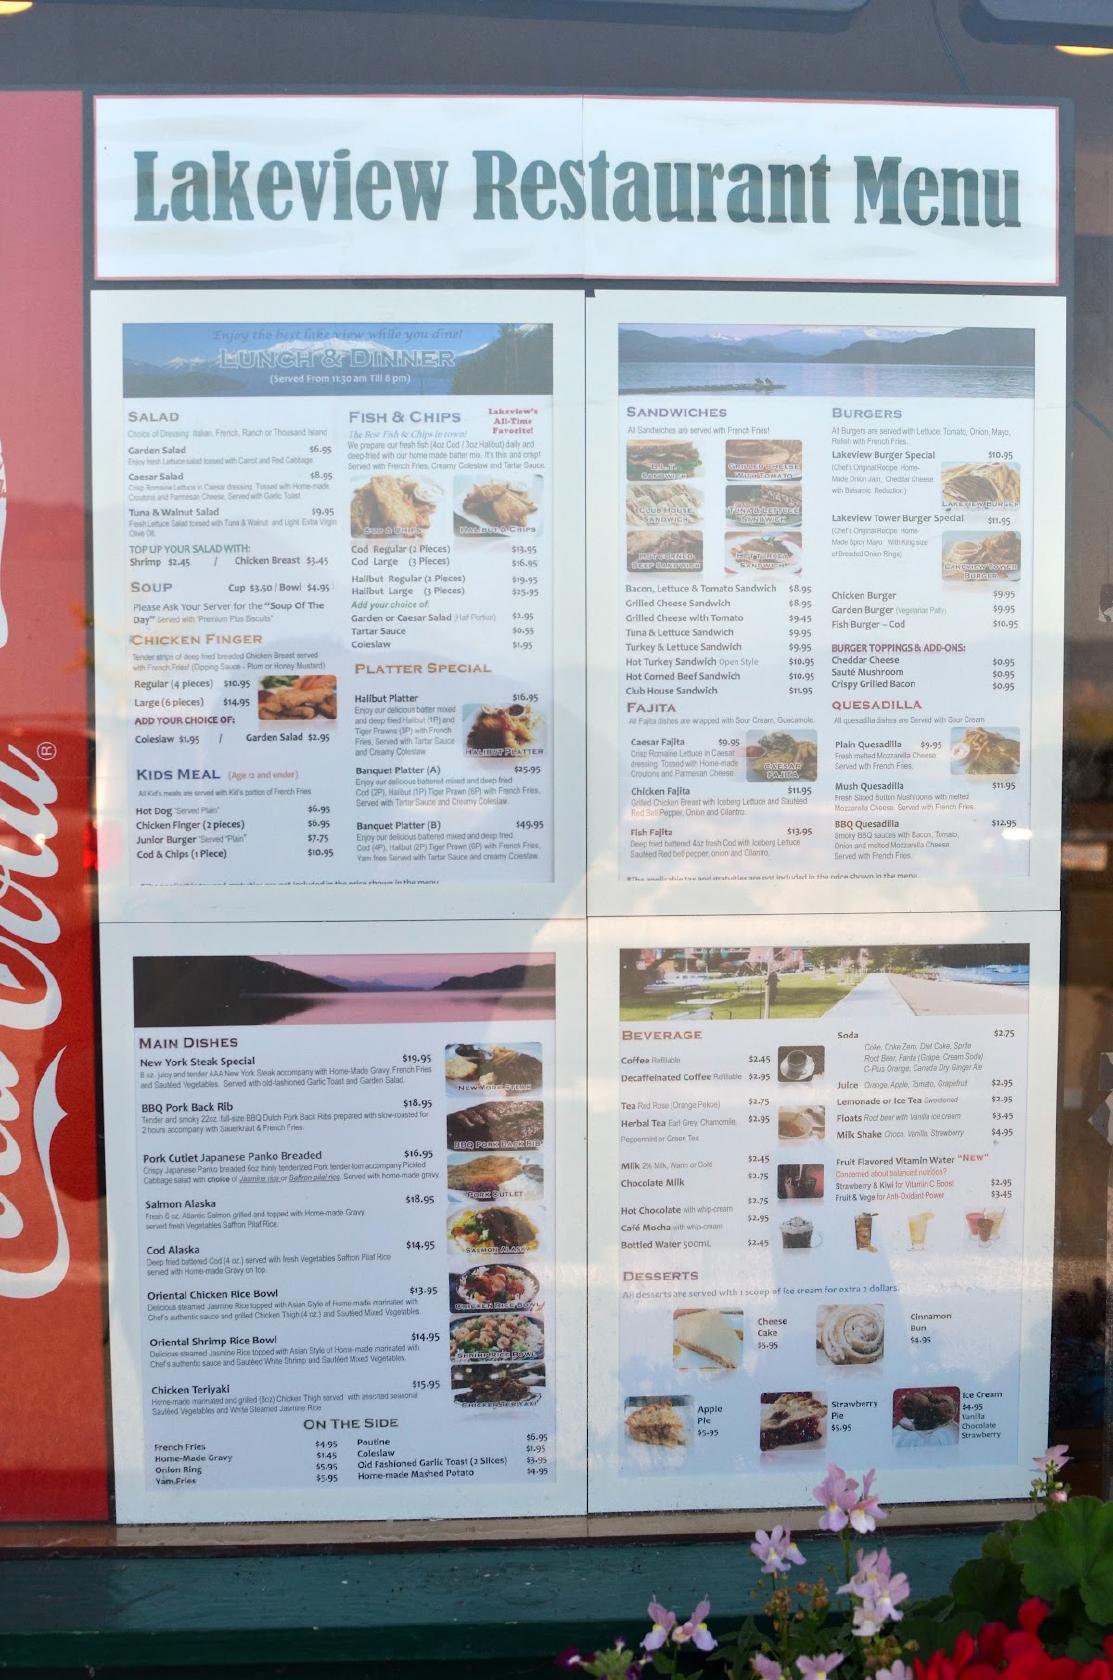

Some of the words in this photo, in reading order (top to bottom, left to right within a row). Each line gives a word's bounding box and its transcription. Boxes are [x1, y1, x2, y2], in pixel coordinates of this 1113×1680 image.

[133, 148, 449, 222] Lakeview
[472, 150, 831, 224] Restaurant
[853, 155, 1022, 228] Menu
[218, 348, 315, 369] LUNCH
[320, 348, 344, 368] &
[351, 348, 456, 368] DINNER
[270, 374, 304, 385] (Served
[306, 374, 330, 383] From
[369, 374, 383, 383] Till
[392, 374, 411, 385] pm)
[128, 411, 180, 422] SALAD
[349, 411, 387, 423] FISH
[391, 411, 405, 423] &
[410, 411, 461, 423] CHIPS
[626, 406, 727, 418] SANDWICHES
[831, 407, 903, 419] BURGERS
[493, 417, 532, 425] All-Time
[128, 446, 160, 455] Garden
[162, 446, 186, 454] Salad
[309, 445, 332, 454] $6.95
[831, 451, 872, 460] Lakeview
[874, 451, 903, 461] Burger
[905, 450, 935, 461] Special
[988, 451, 1013, 460] $10.95
[128, 473, 158, 481] Caesar
[159, 472, 184, 481] Salad
[310, 472, 333, 480] $8.95
[351, 545, 369, 554] Cod
[373, 545, 407, 555] Regular
[419, 544, 451, 555] Pieces)
[129, 558, 161, 567] Shrimp
[168, 558, 191, 567] $2.45
[235, 557, 270, 565] Chicken
[271, 557, 301, 565] Breast
[306, 557, 329, 565] $3.45
[131, 581, 173, 593] SOUP
[228, 584, 246, 593] Cup
[249, 583, 273, 592] $3.50
[279, 583, 302, 592] Bowl
[307, 583, 330, 592] $4.95
[625, 585, 655, 594] Bacon,
[657, 584, 690, 593] Lettuce
[701, 584, 734, 593] Tomato
[735, 584, 777, 593] Sandwich
[788, 584, 812, 594] $8.95
[131, 634, 201, 646] CHICKEN
[205, 633, 263, 645] FINGER
[354, 663, 423, 674] PLATTER
[427, 662, 492, 674] SPECIAL
[831, 668, 855, 677] Sauté
[858, 668, 904, 676] Mushroom
[625, 686, 646, 695] Club
[647, 686, 674, 695] House
[676, 686, 718, 695] Sandwich
[354, 694, 387, 703] Halibut
[389, 693, 418, 703] Platter
[512, 693, 539, 702] $16.95
[626, 702, 677, 713] FAJITA
[831, 700, 923, 710] QUESADILLA
[134, 716, 154, 725] ADD
[156, 716, 183, 725] YOUR
[184, 716, 218, 725] CHOICE
[220, 716, 235, 724] OF:
[136, 769, 173, 781] KIDS
[177, 768, 221, 780] MEAL
[631, 787, 665, 796] Chicken
[667, 786, 690, 796] Fajita
[787, 786, 812, 795] $11.95
[834, 819, 853, 829] BBQ
[855, 819, 900, 829] Quesadilla
[991, 819, 1017, 827] $12.95
[621, 1030, 703, 1041] BEVERAGE
[837, 1031, 859, 1039] Soda
[993, 1029, 1015, 1038] $2.75
[139, 1037, 178, 1049] MAIN
[183, 1037, 238, 1048] DISHES
[140, 1058, 162, 1067] New
[164, 1058, 188, 1067] York
[190, 1057, 218, 1066] Steak
[220, 1056, 255, 1067] Special
[402, 1054, 432, 1064] $19.95
[621, 1056, 650, 1065] Coffee
[748, 1055, 771, 1064] $2.45
[141, 1103, 163, 1114] BBQ
[165, 1103, 188, 1112] Pork
[191, 1102, 214, 1112] Back
[217, 1101, 234, 1112] Rib
[403, 1099, 433, 1108] $18.95
[836, 1130, 856, 1139] Milk
[857, 1130, 882, 1139] Shake
[991, 1128, 1013, 1137] $4.95
[836, 1158, 856, 1166] Fruit
[857, 1157, 894, 1166] Flavored
[895, 1156, 928, 1165] Vitamin
[929, 1156, 955, 1165] Water
[621, 1206, 637, 1215] Hot
[639, 1205, 681, 1215] Chocolate
[622, 1271, 699, 1282] DESSERTS
[910, 1312, 952, 1321] Cinnamon
[757, 1318, 788, 1326] Cheese
[757, 1329, 778, 1337] Cake
[962, 1391, 975, 1399] Ice
[977, 1391, 1003, 1399] Cream
[831, 1400, 878, 1409] Strawberry
[303, 1418, 327, 1430] ON
[332, 1418, 360, 1430] THE
[364, 1418, 399, 1428] SIDE
[357, 1437, 391, 1446] Poutine
[526, 1432, 548, 1442] $6.95
[154, 1443, 183, 1452] French
[184, 1443, 206, 1451] Fries
